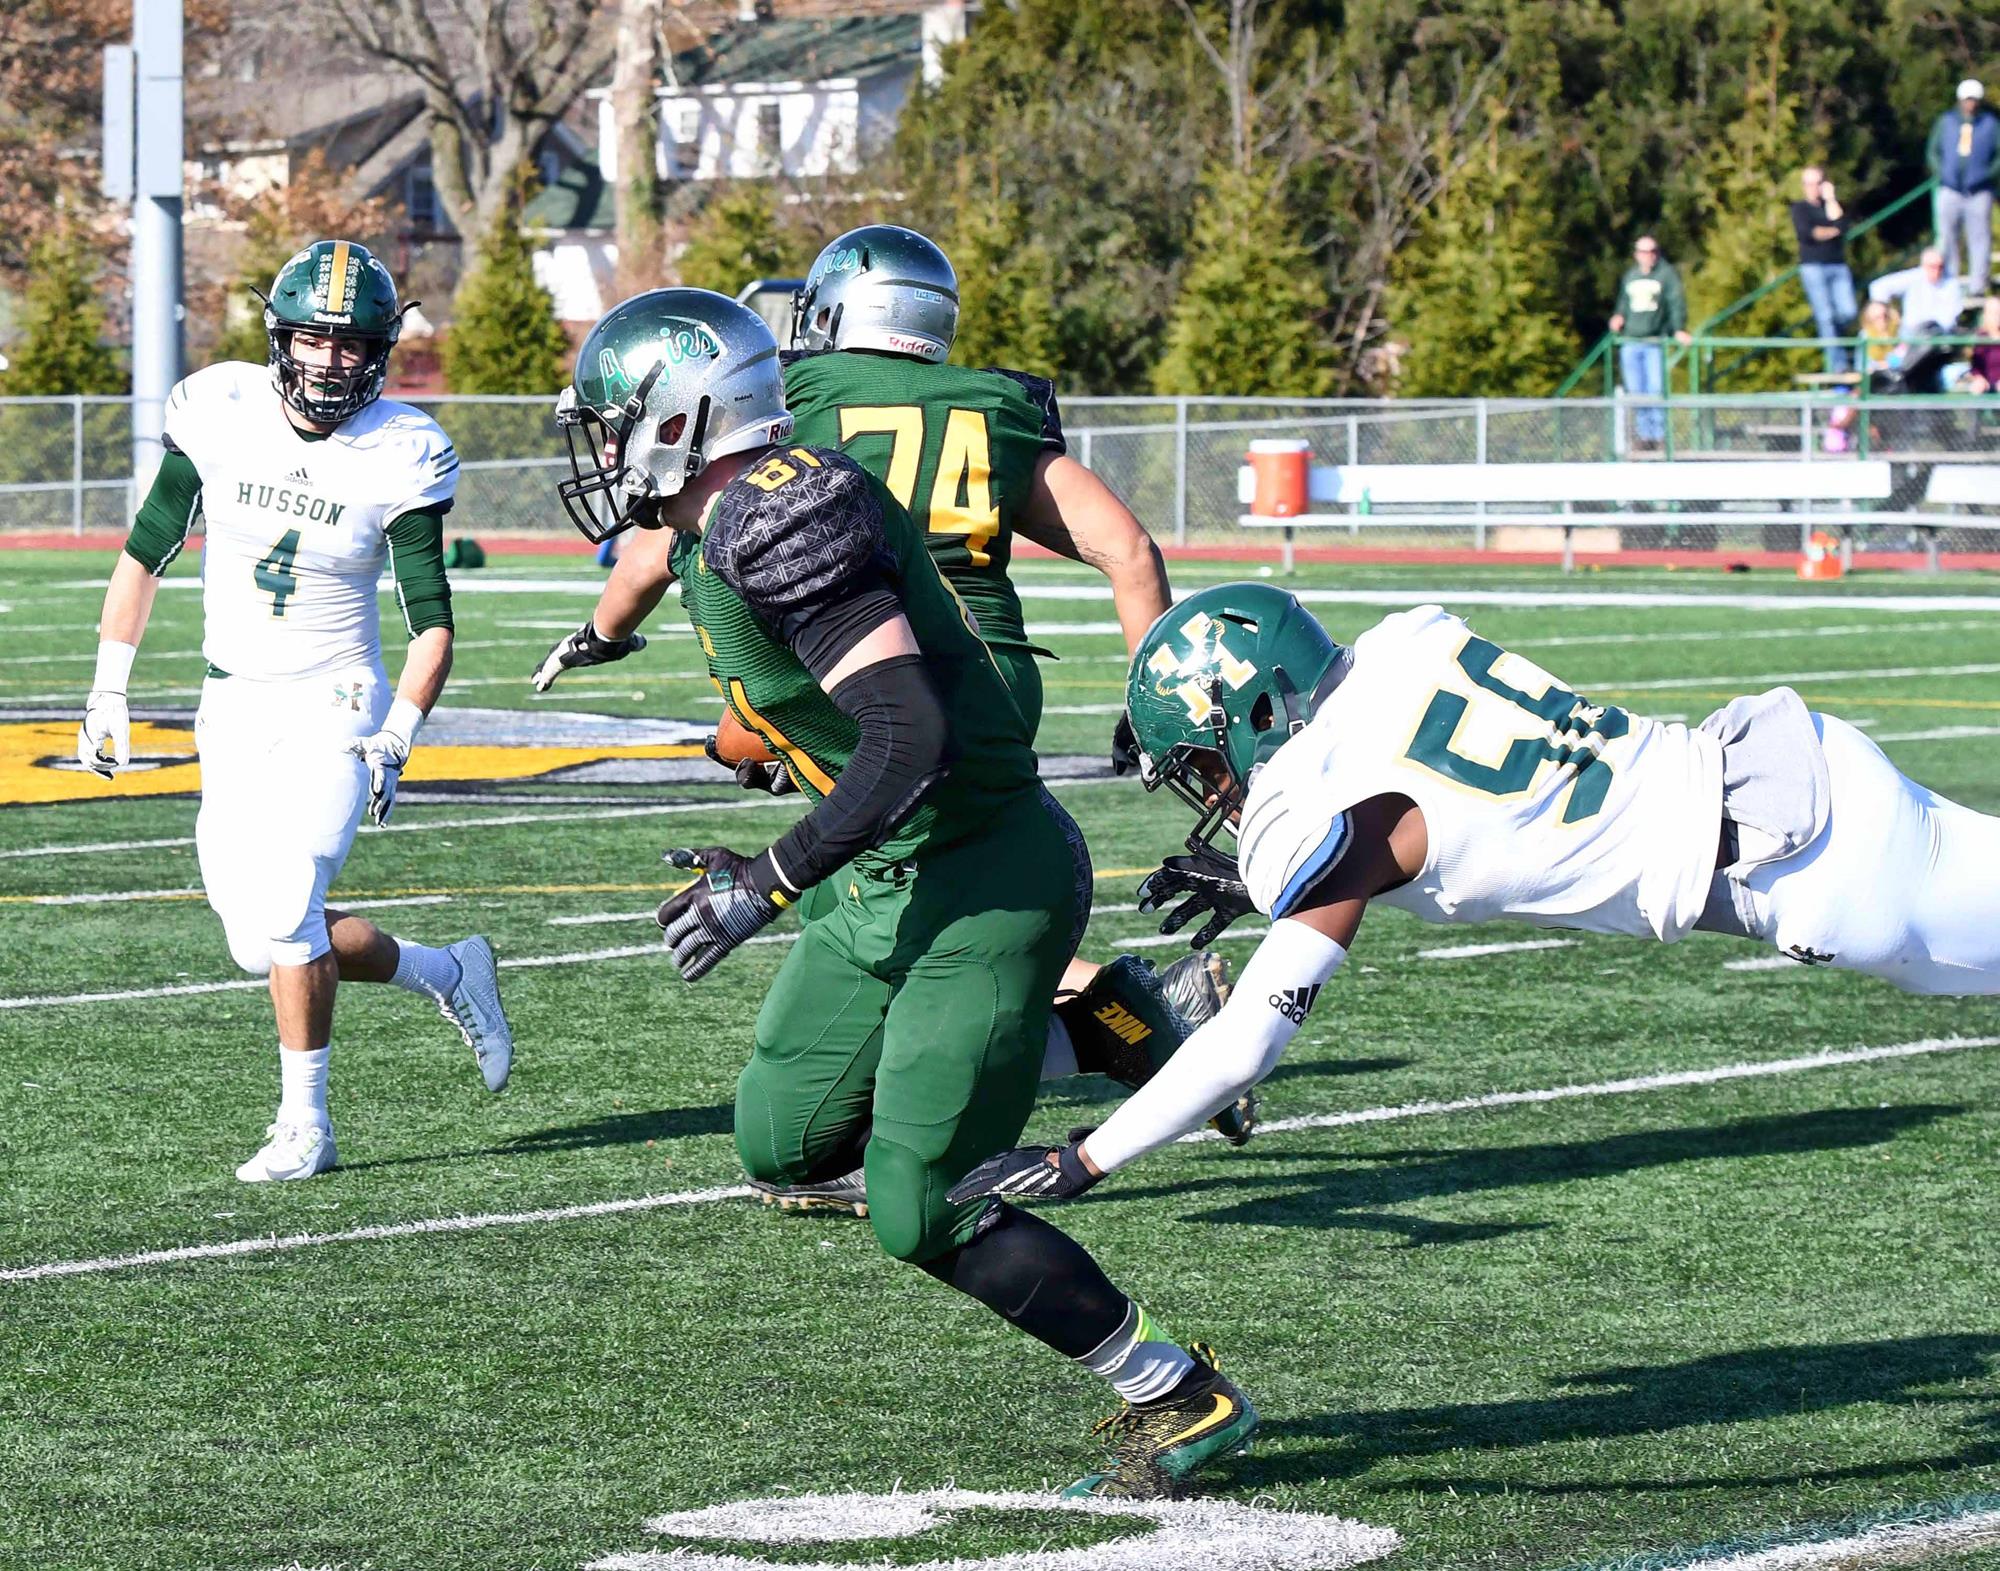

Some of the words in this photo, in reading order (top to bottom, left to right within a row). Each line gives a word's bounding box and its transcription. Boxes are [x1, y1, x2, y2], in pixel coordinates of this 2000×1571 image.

[236, 481, 346, 526] HUSSON
[285, 474, 314, 487] adidas
[837, 404, 1002, 567] 74
[252, 527, 303, 621] 4
[1093, 1000, 1153, 1046] NIKE
